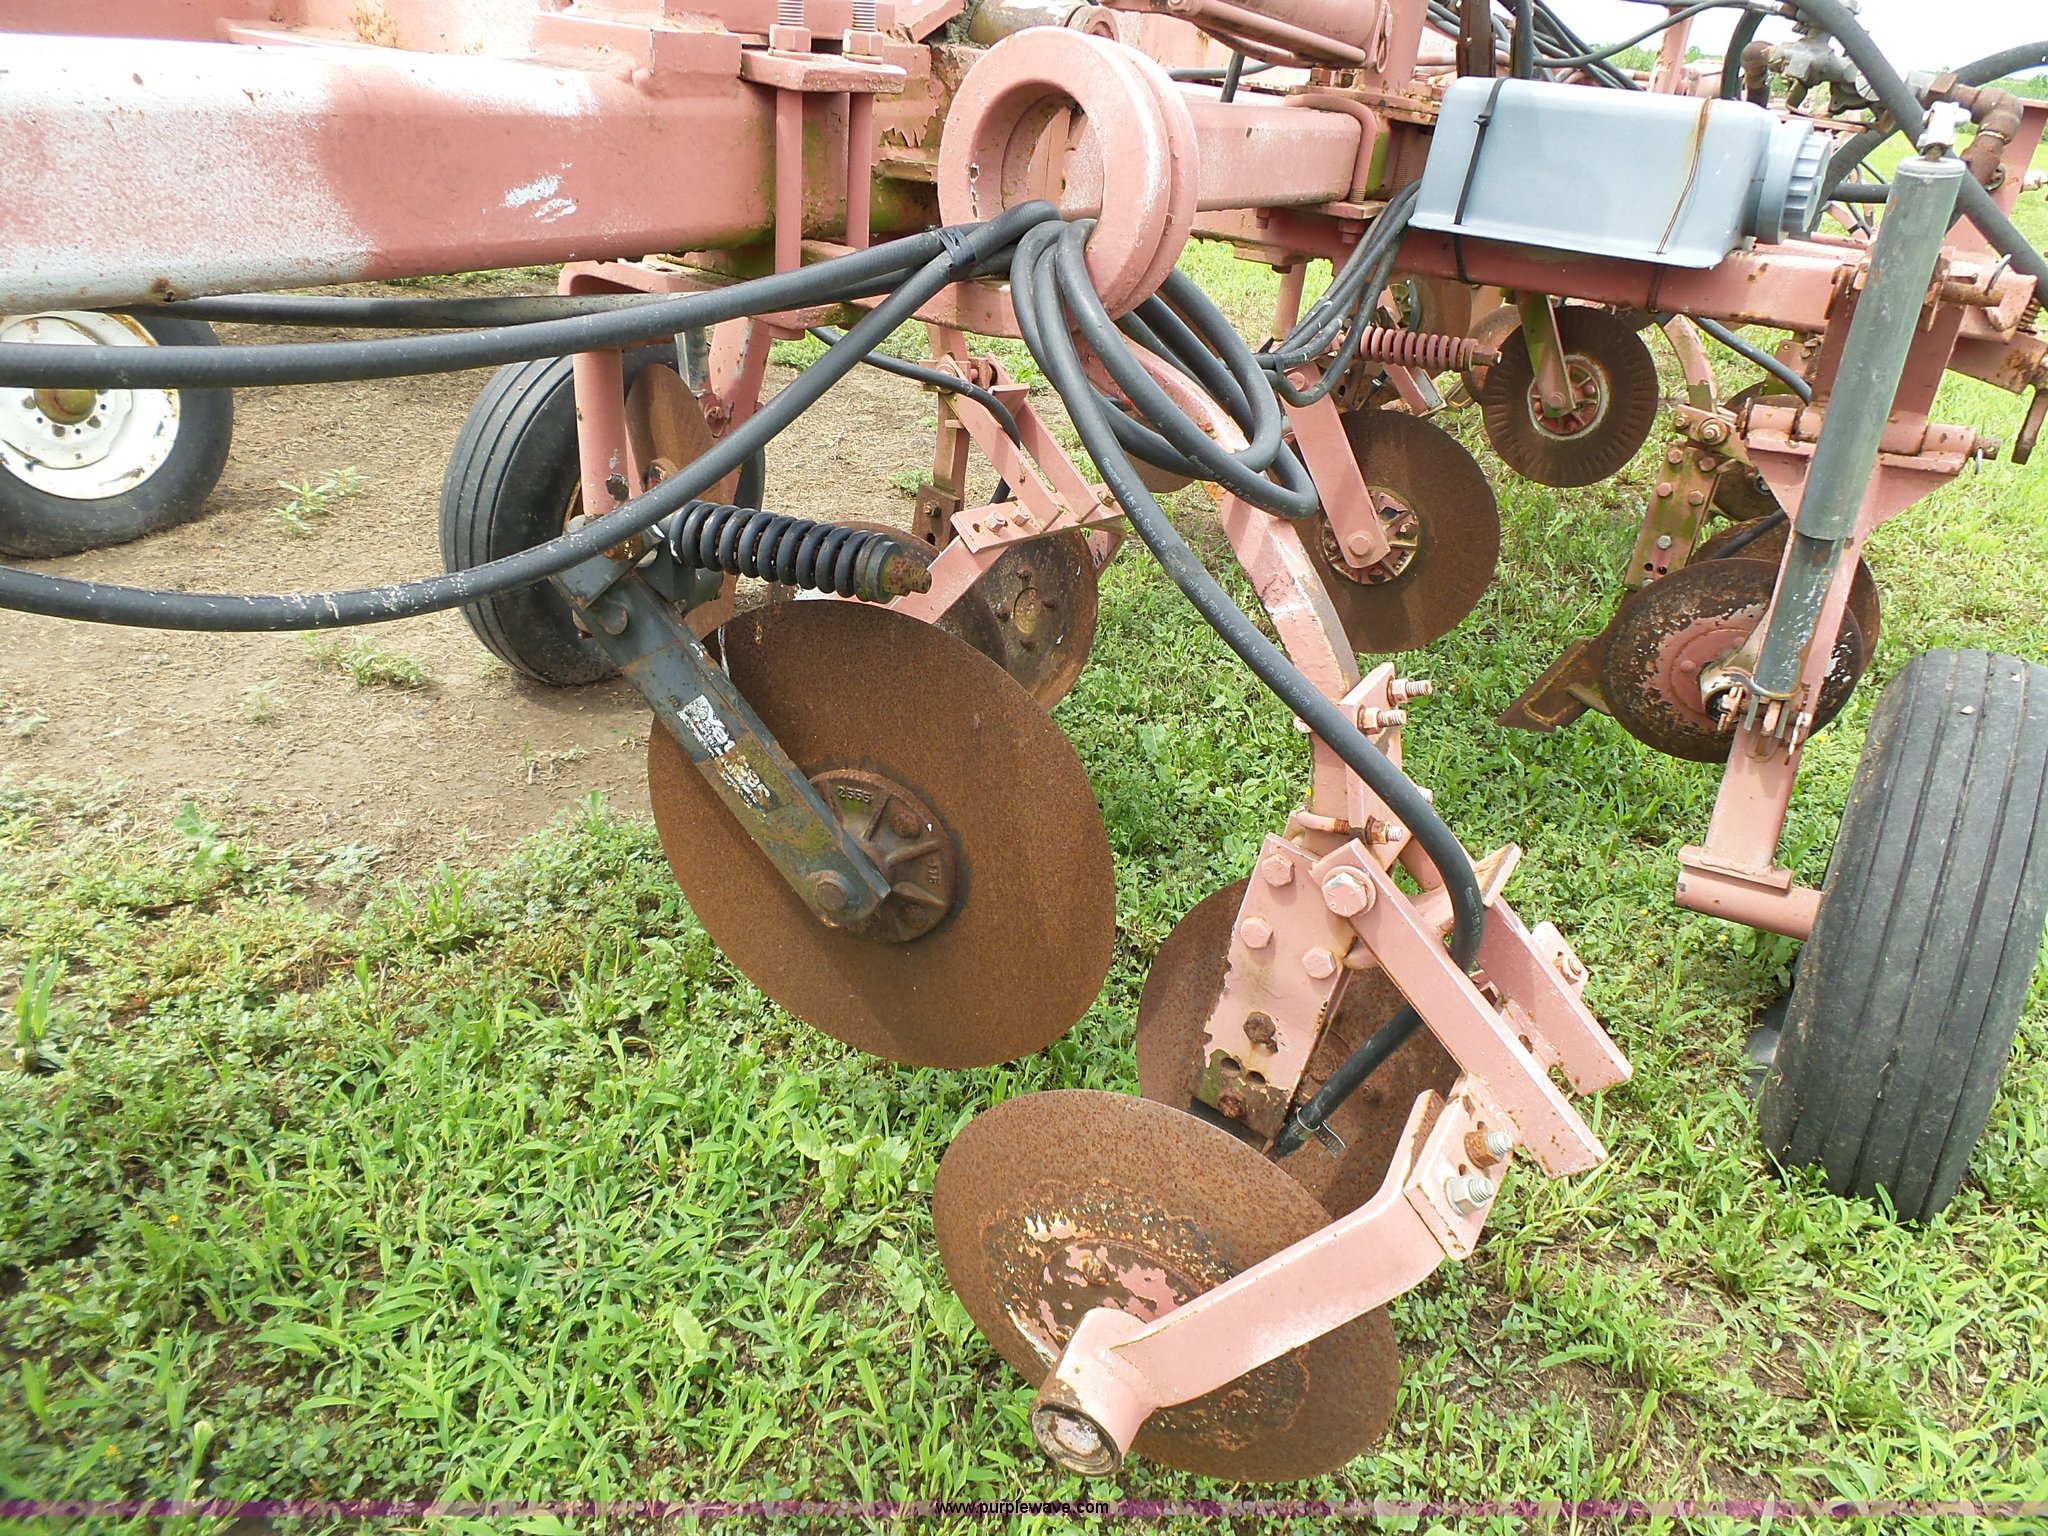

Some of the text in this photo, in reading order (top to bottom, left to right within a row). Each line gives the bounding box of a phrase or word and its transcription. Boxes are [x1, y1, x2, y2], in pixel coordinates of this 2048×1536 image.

[1133, 506, 1144, 521] Ag
[1141, 518, 1159, 542] Spray
[705, 705, 771, 800] Yeter
